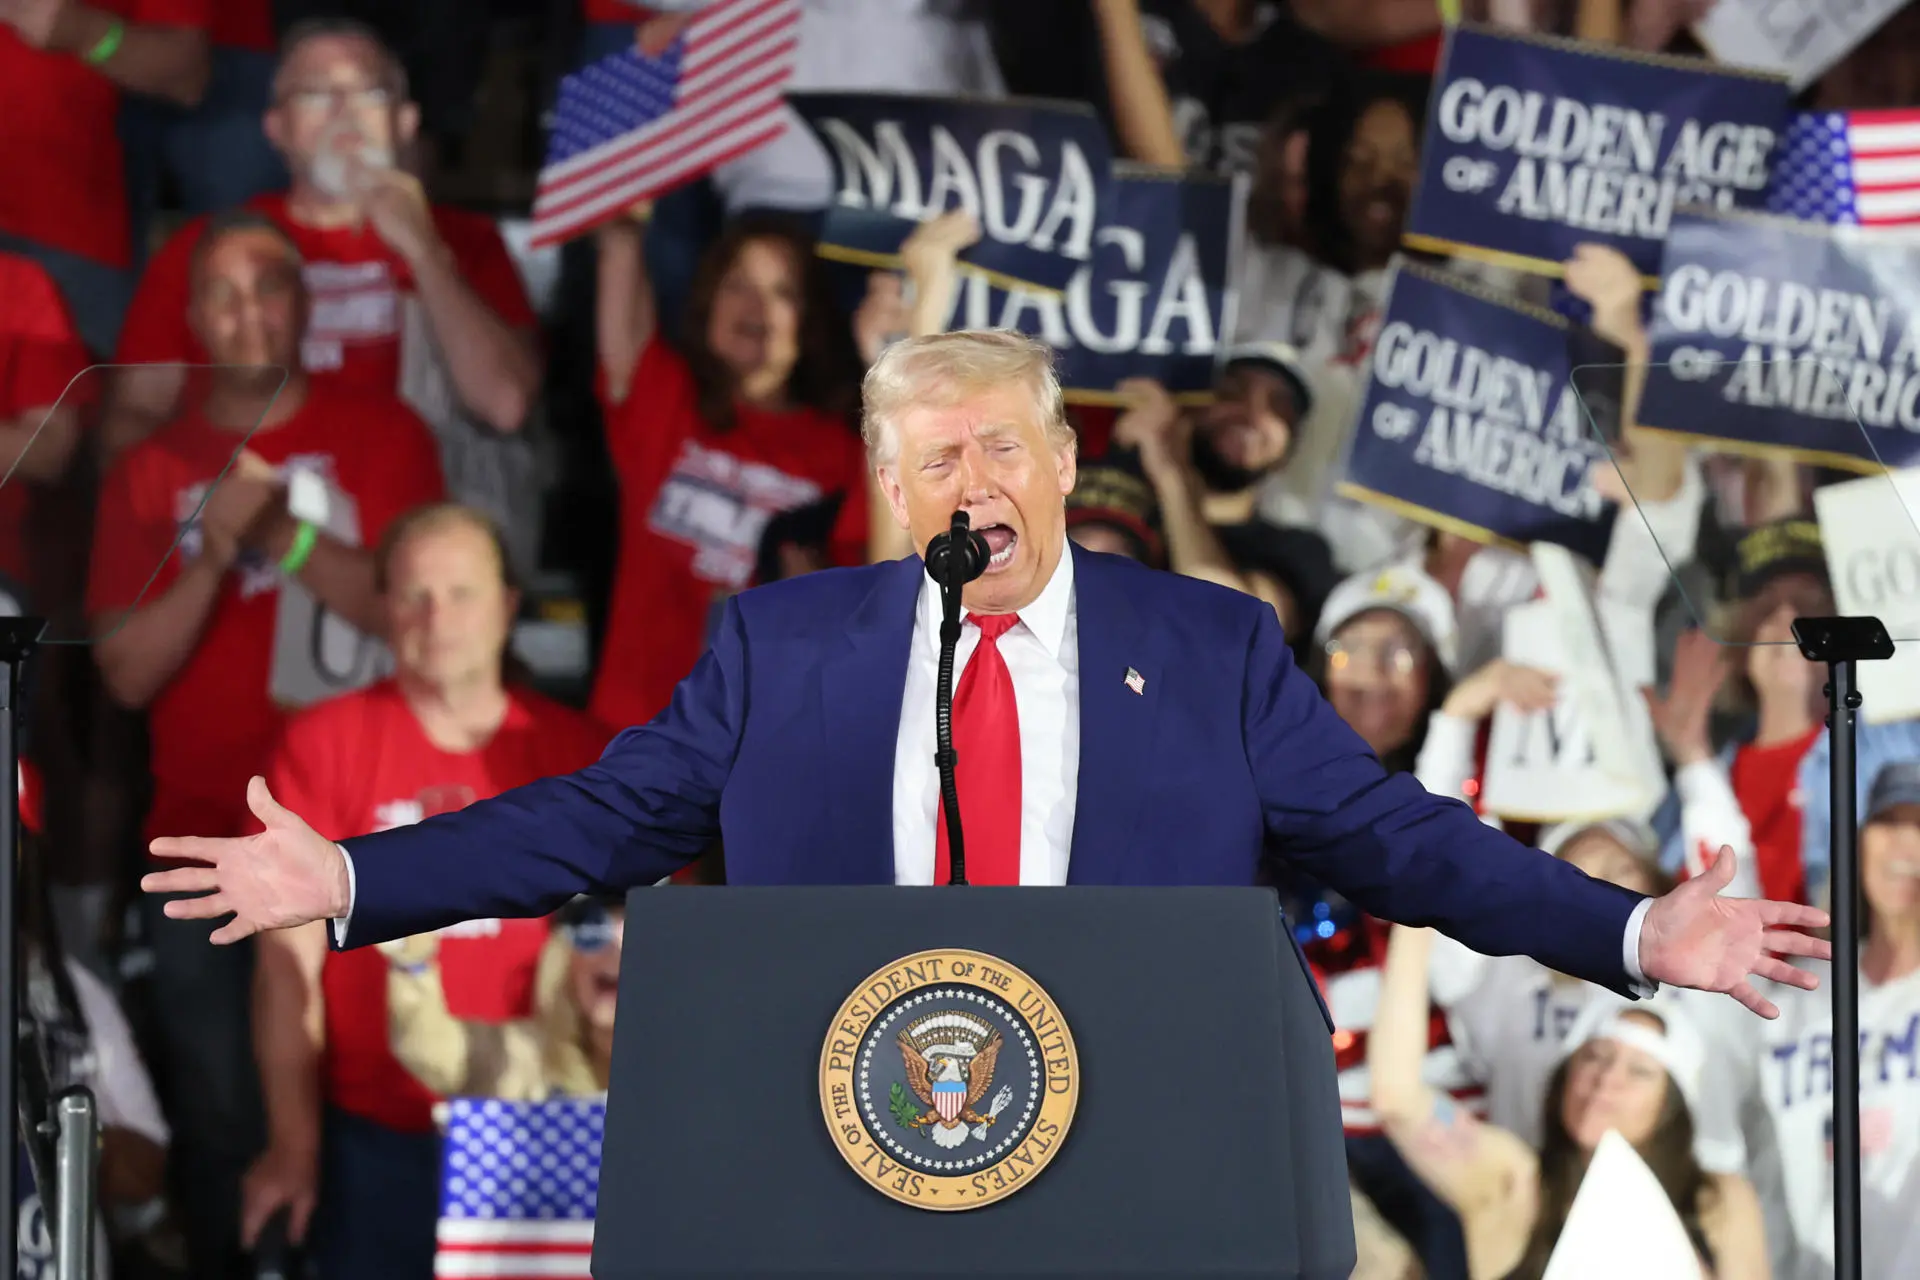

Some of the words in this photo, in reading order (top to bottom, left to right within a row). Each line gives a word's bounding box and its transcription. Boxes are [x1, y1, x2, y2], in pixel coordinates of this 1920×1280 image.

[1438, 77, 1667, 173] GOLDEN
[1663, 118, 1776, 191] AGE
[818, 115, 1097, 261] MAGA
[1441, 154, 1500, 194] OF
[1496, 157, 1738, 241] AMERI
[1664, 263, 1890, 363] GOLDEN
[1373, 320, 1553, 434] GOLDEN
[1668, 345, 1726, 383] OF
[951, 961, 976, 977] OF
[980, 966, 1013, 991] THE
[829, 958, 943, 1073] PRESIDENT
[1017, 988, 1070, 1095] UNITED
[831, 1082, 851, 1119] THE
[840, 1122, 862, 1146] OF
[860, 1140, 925, 1197] SEAL
[971, 1118, 1059, 1198] STATES
